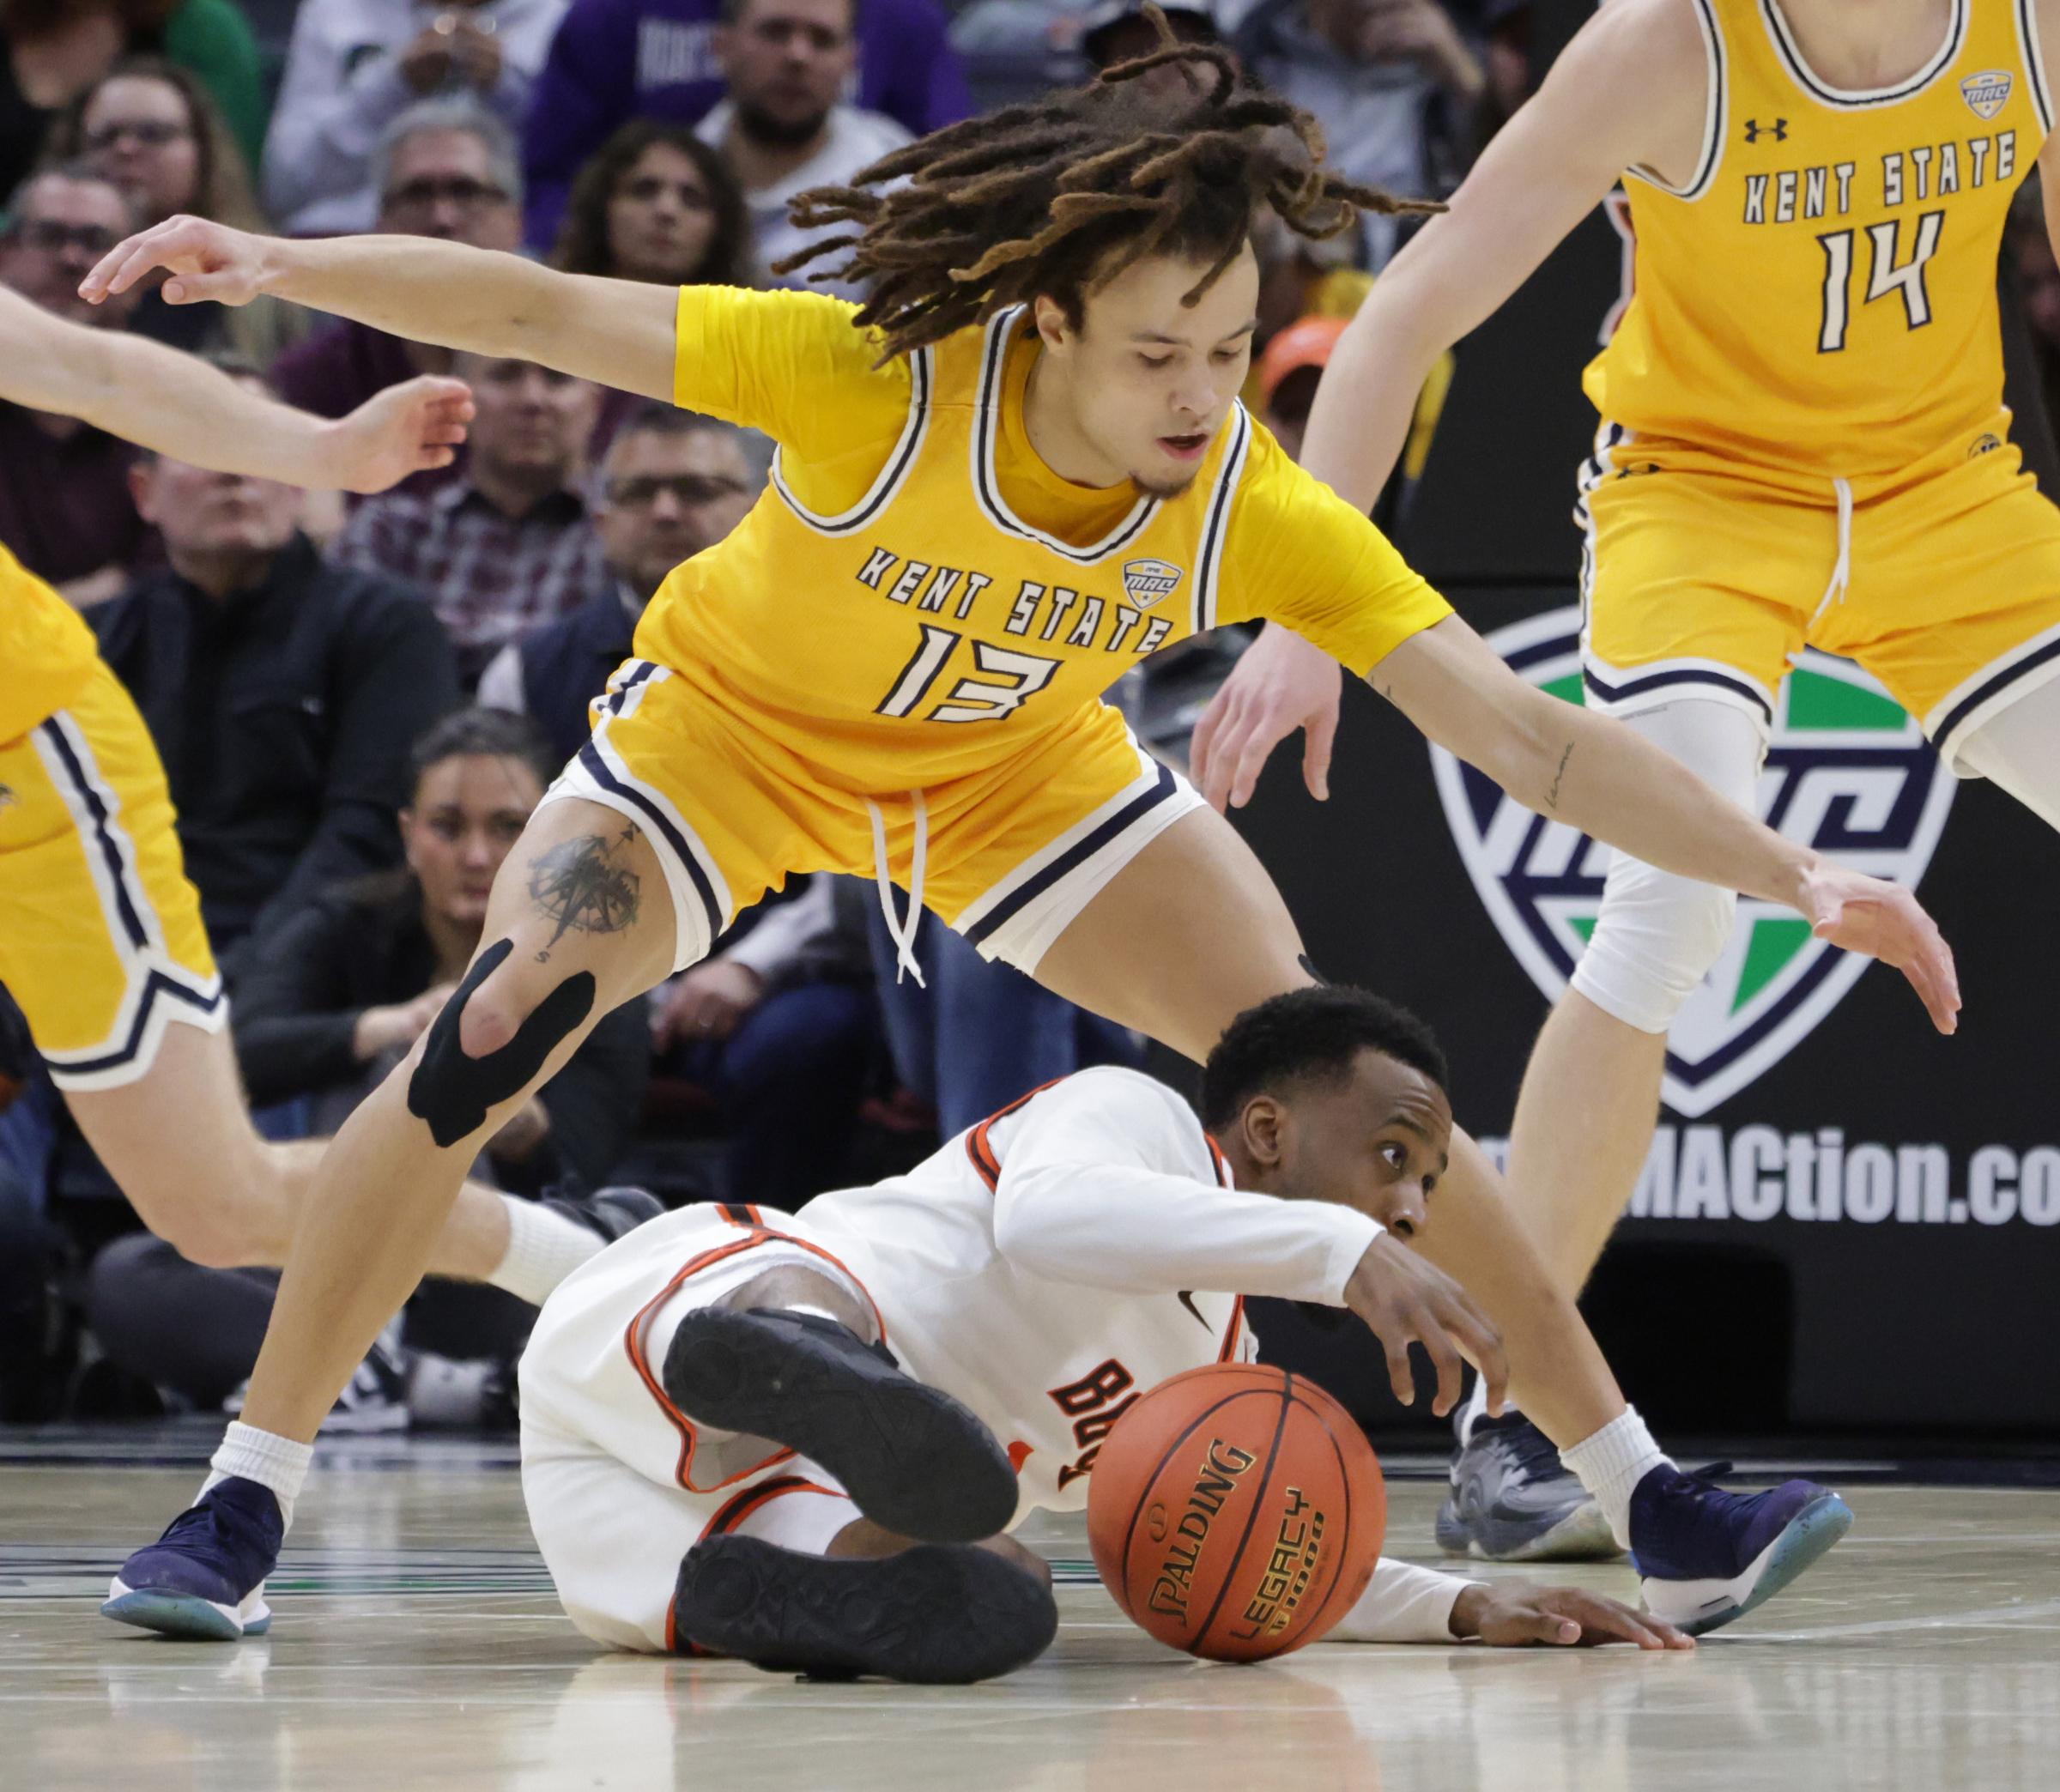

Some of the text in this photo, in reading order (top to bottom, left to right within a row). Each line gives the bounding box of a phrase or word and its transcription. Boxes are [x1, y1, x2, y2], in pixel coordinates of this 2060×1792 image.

[1965, 86, 2009, 103] MAC
[1743, 129, 2015, 224] KENT STATE
[1815, 209, 1946, 354] 14
[857, 546, 1174, 653] KENT STATE
[1125, 574, 1177, 591] MAC
[872, 623, 1064, 723] 13
[1148, 1438, 1257, 1628] SPALDING
[1228, 1486, 1310, 1641] LEGACY
